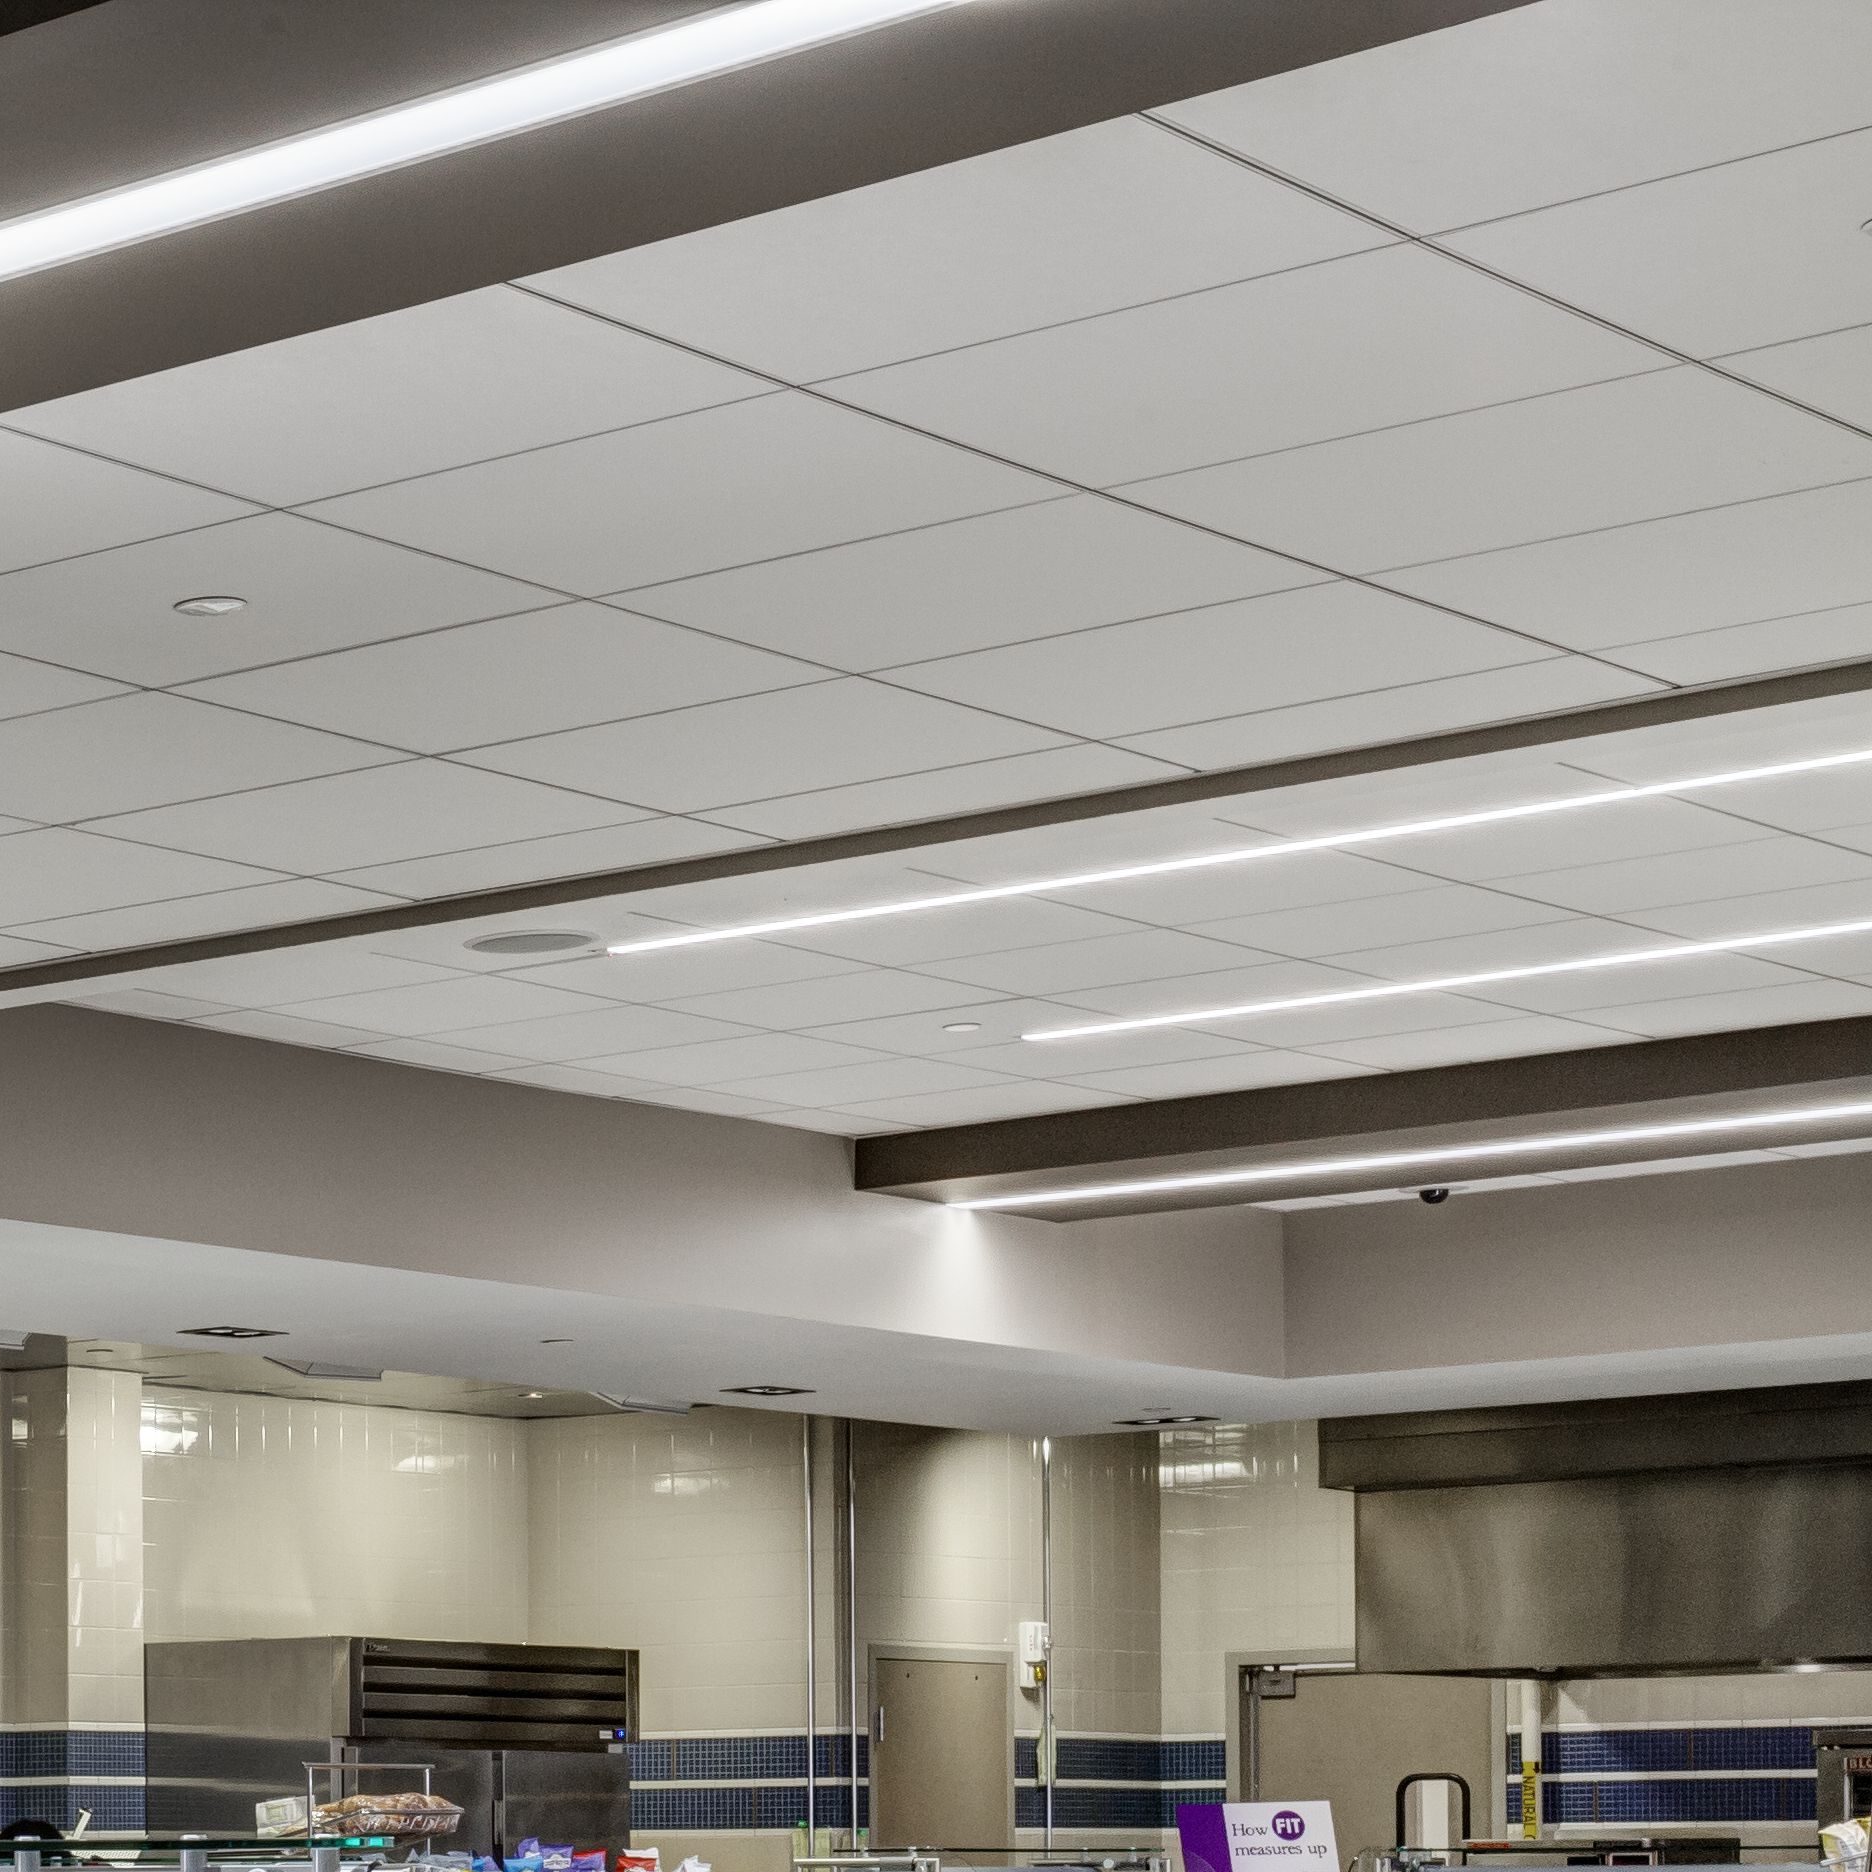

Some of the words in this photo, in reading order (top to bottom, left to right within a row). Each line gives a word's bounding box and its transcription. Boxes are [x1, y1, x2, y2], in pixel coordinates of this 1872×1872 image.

[1522, 1775, 1538, 1828] NATURAL
[1231, 1823, 1269, 1837] How
[1275, 1817, 1301, 1834] FIT
[1235, 1844, 1303, 1857] measures
[1308, 1844, 1328, 1859] up
